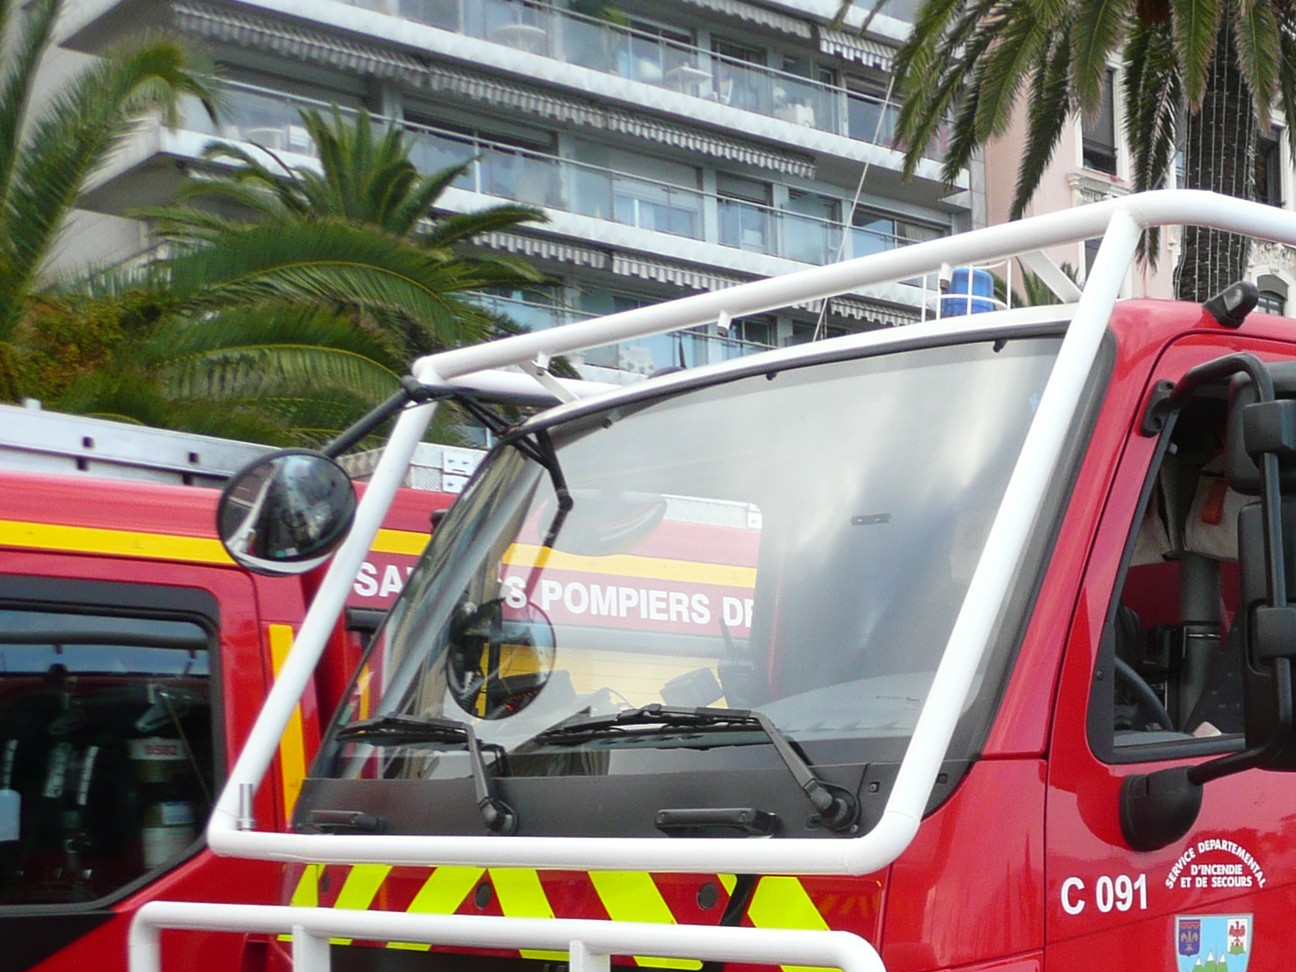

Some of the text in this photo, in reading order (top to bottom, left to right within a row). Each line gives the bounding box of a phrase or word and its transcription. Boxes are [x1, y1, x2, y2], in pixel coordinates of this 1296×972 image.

[541, 579, 711, 626] POMPIERS
[1165, 838, 1267, 890] SERVICE DEPARTEMENTAL
[1180, 875, 1252, 888] ET DE SECOURS
[1190, 864, 1243, 876] D'INCENDIE
[1060, 873, 1147, 915] C 091
